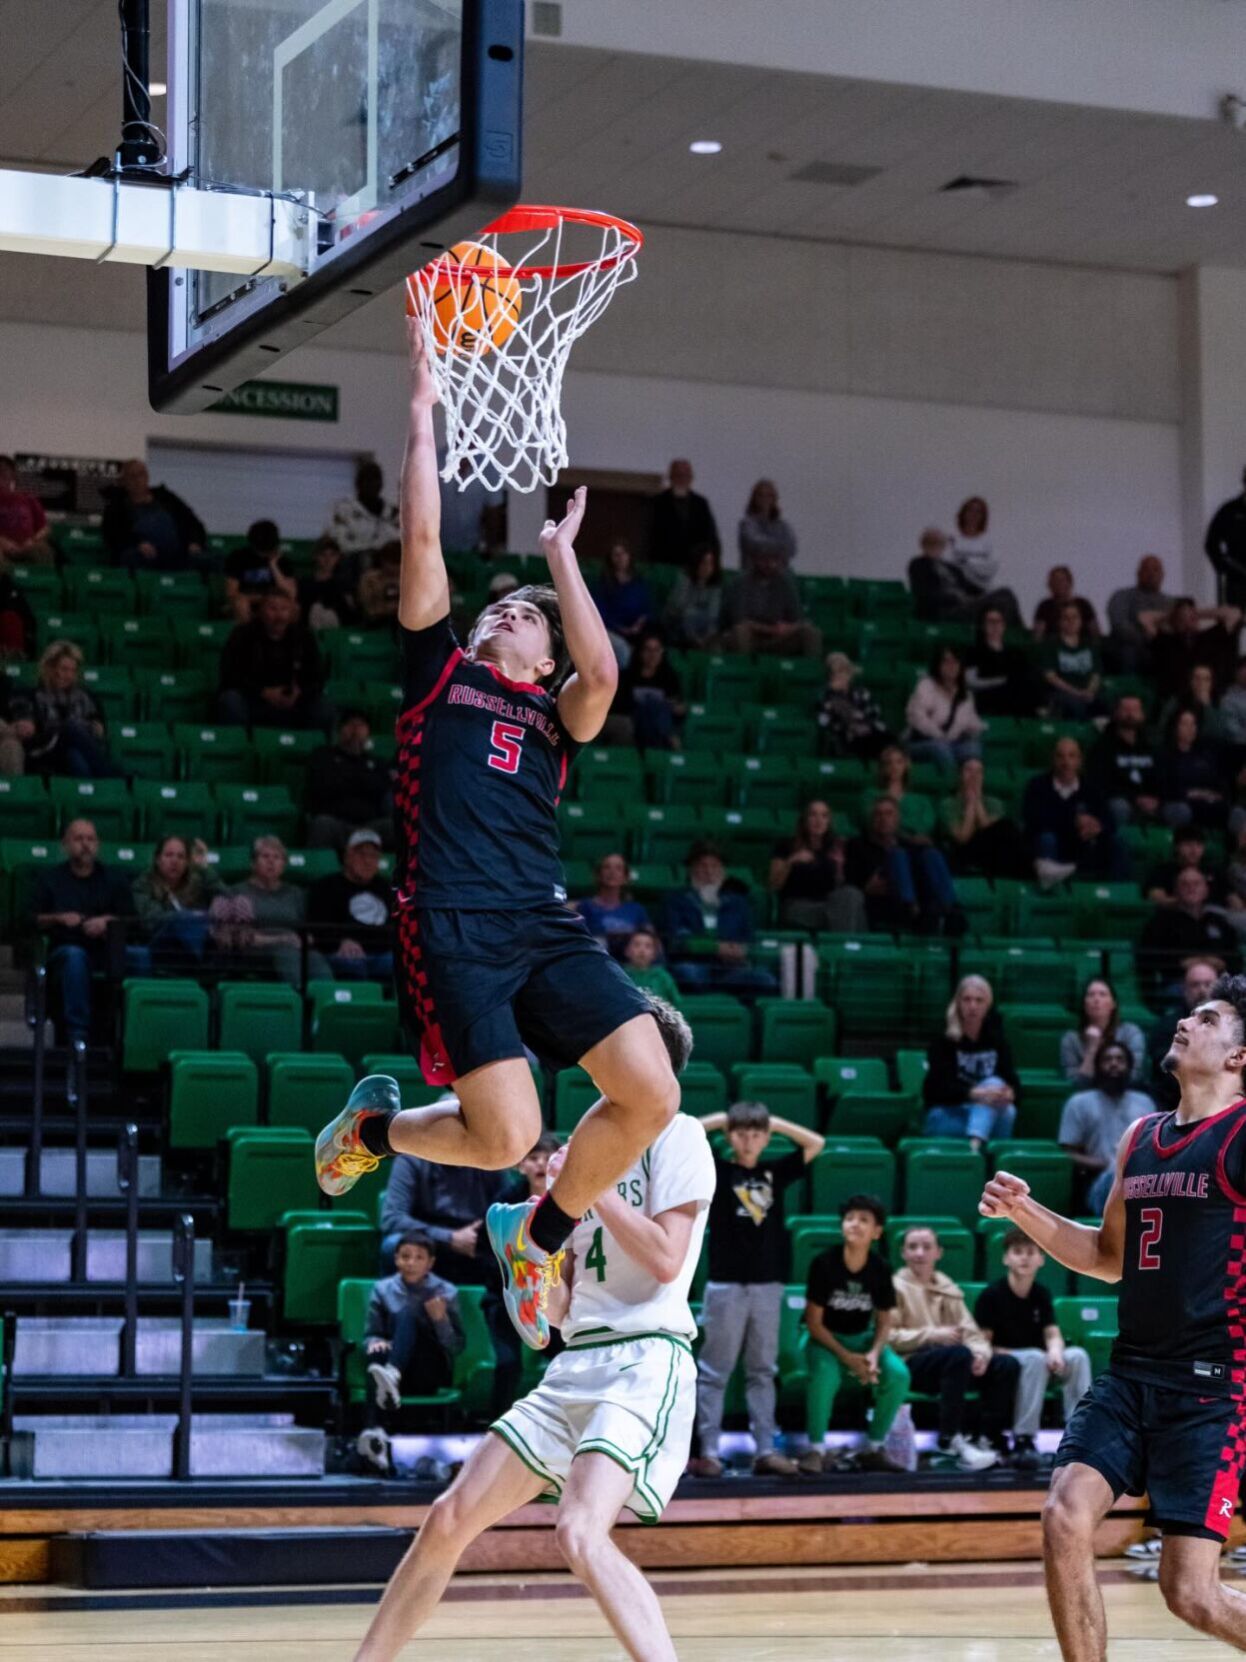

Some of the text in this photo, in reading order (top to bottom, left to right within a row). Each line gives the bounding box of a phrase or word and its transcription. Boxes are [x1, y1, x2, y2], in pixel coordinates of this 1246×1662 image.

[222, 388, 334, 415] NCESSION
[487, 720, 527, 774] 5
[585, 1226, 607, 1282] 4
[1138, 1207, 1164, 1270] 2
[1218, 1497, 1233, 1519] R
